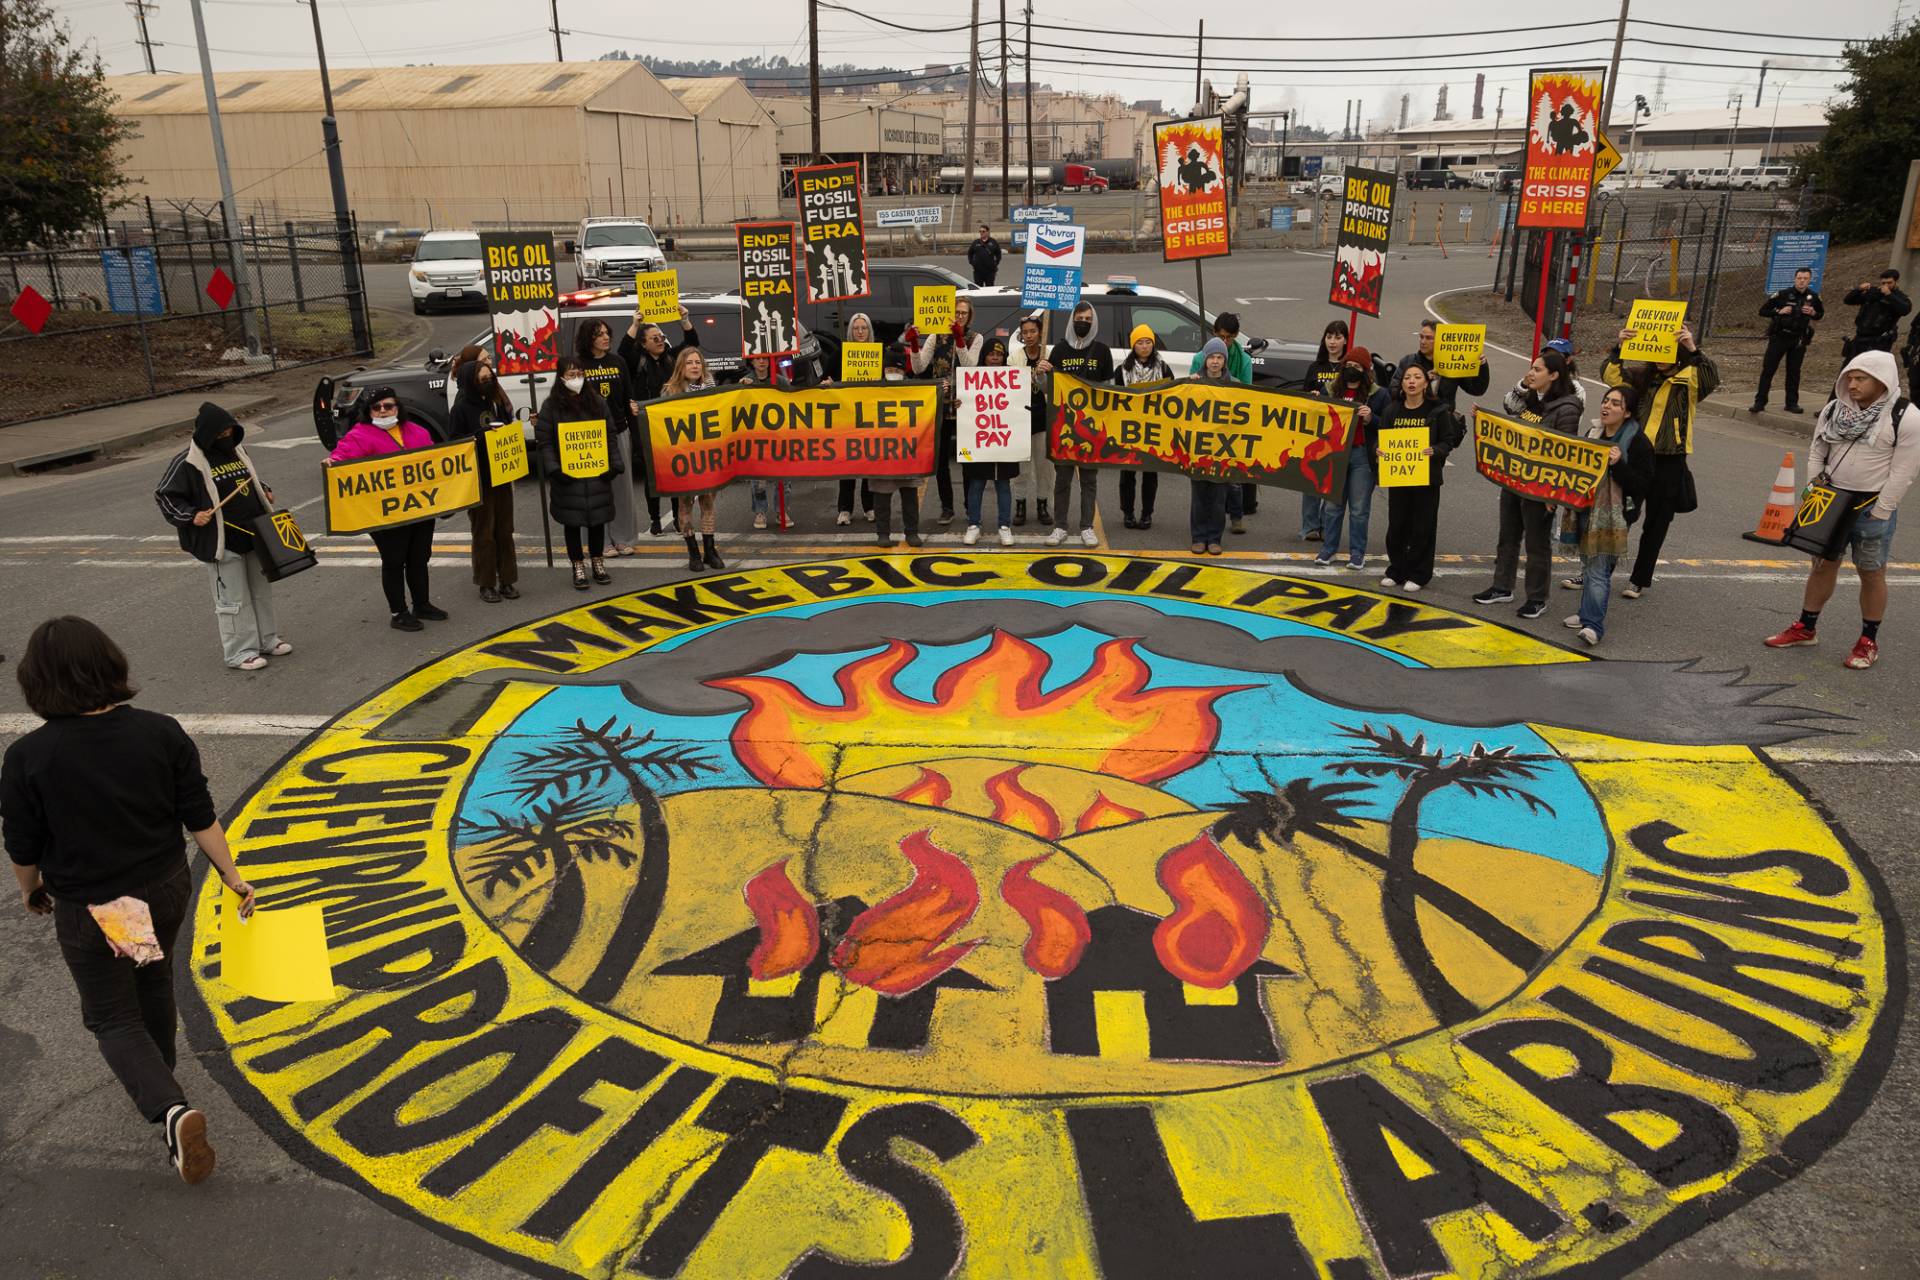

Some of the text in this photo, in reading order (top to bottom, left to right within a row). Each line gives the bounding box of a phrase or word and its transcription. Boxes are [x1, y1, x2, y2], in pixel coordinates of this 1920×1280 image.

[1529, 167, 1590, 181] THE CLIMATE
[803, 175, 855, 191] END THE
[804, 190, 857, 207] FOSSIL
[1347, 177, 1390, 209] BIG OIL
[1526, 185, 1587, 198] CRISIS
[806, 206, 858, 222] FUEL
[891, 209, 916, 218] CASTRO
[917, 208, 940, 216] STREET
[1166, 201, 1224, 219] THE CLIMATE
[1345, 202, 1390, 223] PROFITS
[1523, 201, 1585, 215] IS HERE
[807, 222, 859, 241] ERA
[1037, 224, 1075, 237] Chevron
[1167, 217, 1225, 234] CRISIS
[1344, 217, 1387, 241] LA BURNS
[743, 234, 778, 247] END
[1167, 232, 1225, 248] IS HERE
[488, 245, 550, 268] BIG OIL
[744, 249, 790, 263] FOSSIL
[491, 268, 552, 284] PROFITS
[745, 264, 791, 278] FUEL
[642, 278, 675, 290] CHEVRON
[745, 279, 792, 296] ERA
[1025, 283, 1057, 292] DISPLACED
[493, 283, 554, 301] LA BURNS
[643, 289, 676, 299] PROFITS
[1024, 290, 1056, 299] STRUCTURES
[655, 299, 667, 307] LA
[922, 295, 948, 304] MAKE
[1023, 299, 1048, 307] DAMAGES
[645, 306, 677, 316] BURNS
[919, 305, 952, 315] BIG OIL
[1636, 309, 1680, 321] CHEVRON
[925, 316, 946, 326] PAY
[1632, 321, 1676, 333] PROFITS
[1441, 332, 1480, 342] CHEVRON
[1643, 333, 1658, 342] LA
[847, 350, 880, 359] CHEVRON
[1440, 344, 1479, 352] PROFITS
[1627, 343, 1672, 354] BURNS
[847, 360, 880, 368] PROFITS
[1062, 359, 1098, 367] SUNRSE
[1438, 362, 1477, 370] BURNS
[428, 380, 444, 388] 1137
[964, 370, 1021, 391] MAKE
[975, 392, 1009, 412] BIG
[1067, 388, 1329, 438] OUR HOMES WILL
[664, 400, 925, 445] WE WONT LET
[975, 414, 1008, 429] OIL
[1394, 418, 1425, 426] SUNRIS
[496, 433, 519, 448] MAKE
[565, 429, 602, 441] CHEVRON
[976, 430, 1011, 449] PAY
[1120, 420, 1263, 458] BE NEXT
[566, 441, 603, 451] PROFITS
[1388, 440, 1419, 448] MAKE
[1480, 419, 1604, 470] BIG OIL PROFITS
[494, 445, 523, 462] BIG OIL
[579, 452, 593, 461] LA
[671, 438, 918, 478] OUR FUTURES BURN
[1384, 452, 1424, 461] BIG OIL
[502, 458, 520, 473] PAY
[567, 460, 605, 470] BURNS
[1390, 465, 1416, 475] PAY
[1482, 447, 1595, 495] LA BURNS
[337, 454, 472, 498] MAKE BIG OIL
[381, 487, 439, 517] PAY
[481, 556, 1479, 673] MAKE BIG OIL PAY
[226, 917, 984, 1280] PROFITS
[1065, 1073, 1571, 1280] LA
[1453, 820, 1866, 1187] BURNS
